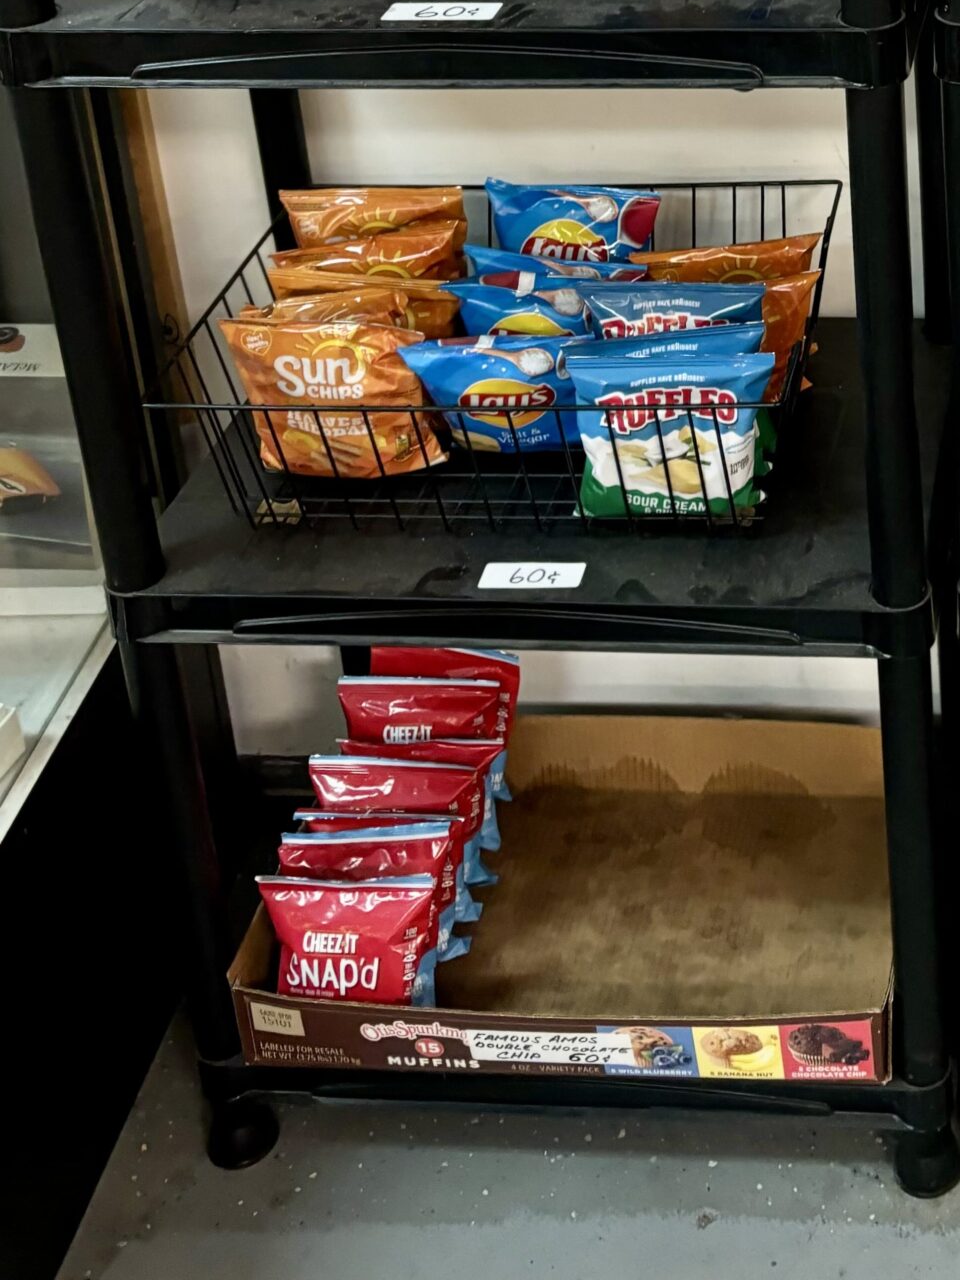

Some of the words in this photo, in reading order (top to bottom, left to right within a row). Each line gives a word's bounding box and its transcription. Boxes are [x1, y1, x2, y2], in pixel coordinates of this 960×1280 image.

[414, 5, 480, 19] 60¢
[274, 354, 367, 398] Sun
[307, 383, 365, 400] CHIPS
[470, 388, 548, 416] Lay's
[598, 387, 737, 433] RUFFLES
[508, 566, 561, 586] 60¢
[473, 1032, 542, 1044] FAMOUS
[549, 1034, 598, 1044] AMOS
[417, 1041, 441, 1054] 15
[475, 1041, 534, 1052] DOUBLE
[541, 1044, 634, 1054] CHOCOLATE
[387, 1055, 480, 1069] MUFFINS
[496, 1051, 542, 1060] CHIP
[568, 1052, 611, 1063] 60¢
[539, 1064, 575, 1072] VARIETY
[642, 1068, 693, 1076] BLUEBERRY
[792, 1070, 843, 1079] CHOCOLATE
[846, 1070, 868, 1078] CHIP
[806, 1065, 859, 1073] CHOCOLATE
